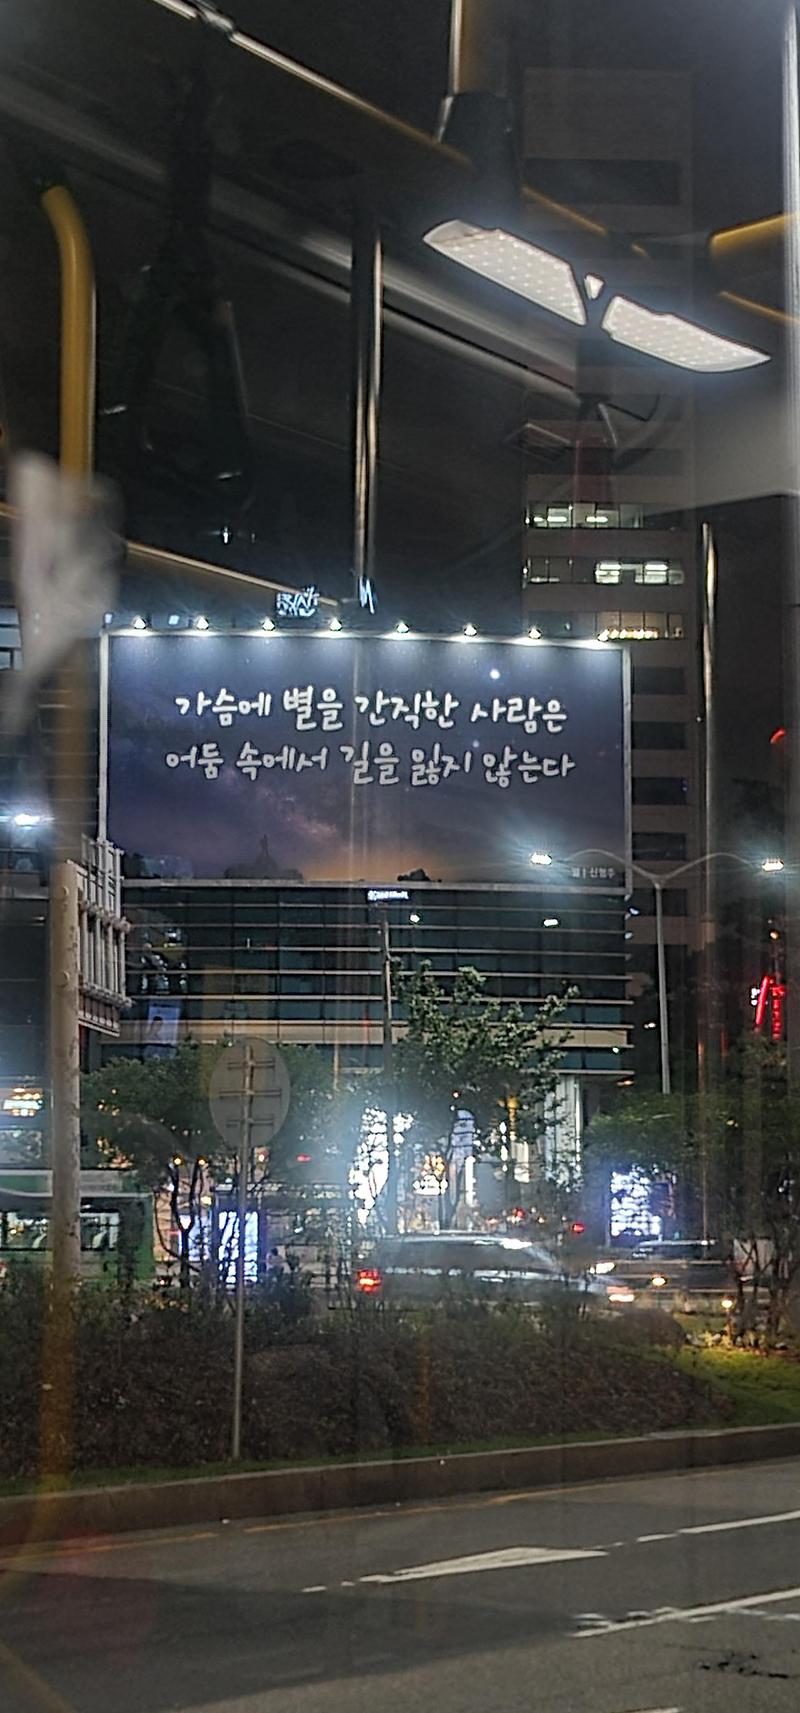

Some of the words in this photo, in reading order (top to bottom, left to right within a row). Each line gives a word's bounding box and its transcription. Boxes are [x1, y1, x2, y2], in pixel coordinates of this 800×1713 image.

[175, 687, 272, 727] 가슴에
[282, 684, 343, 731] 별을
[354, 689, 460, 730] 간직한
[470, 696, 567, 734] 사람은
[166, 743, 224, 779] 어둠
[236, 741, 328, 781] 속에서
[339, 740, 399, 785] 길을
[411, 743, 472, 786] 잃지
[483, 746, 575, 788] 않는다
